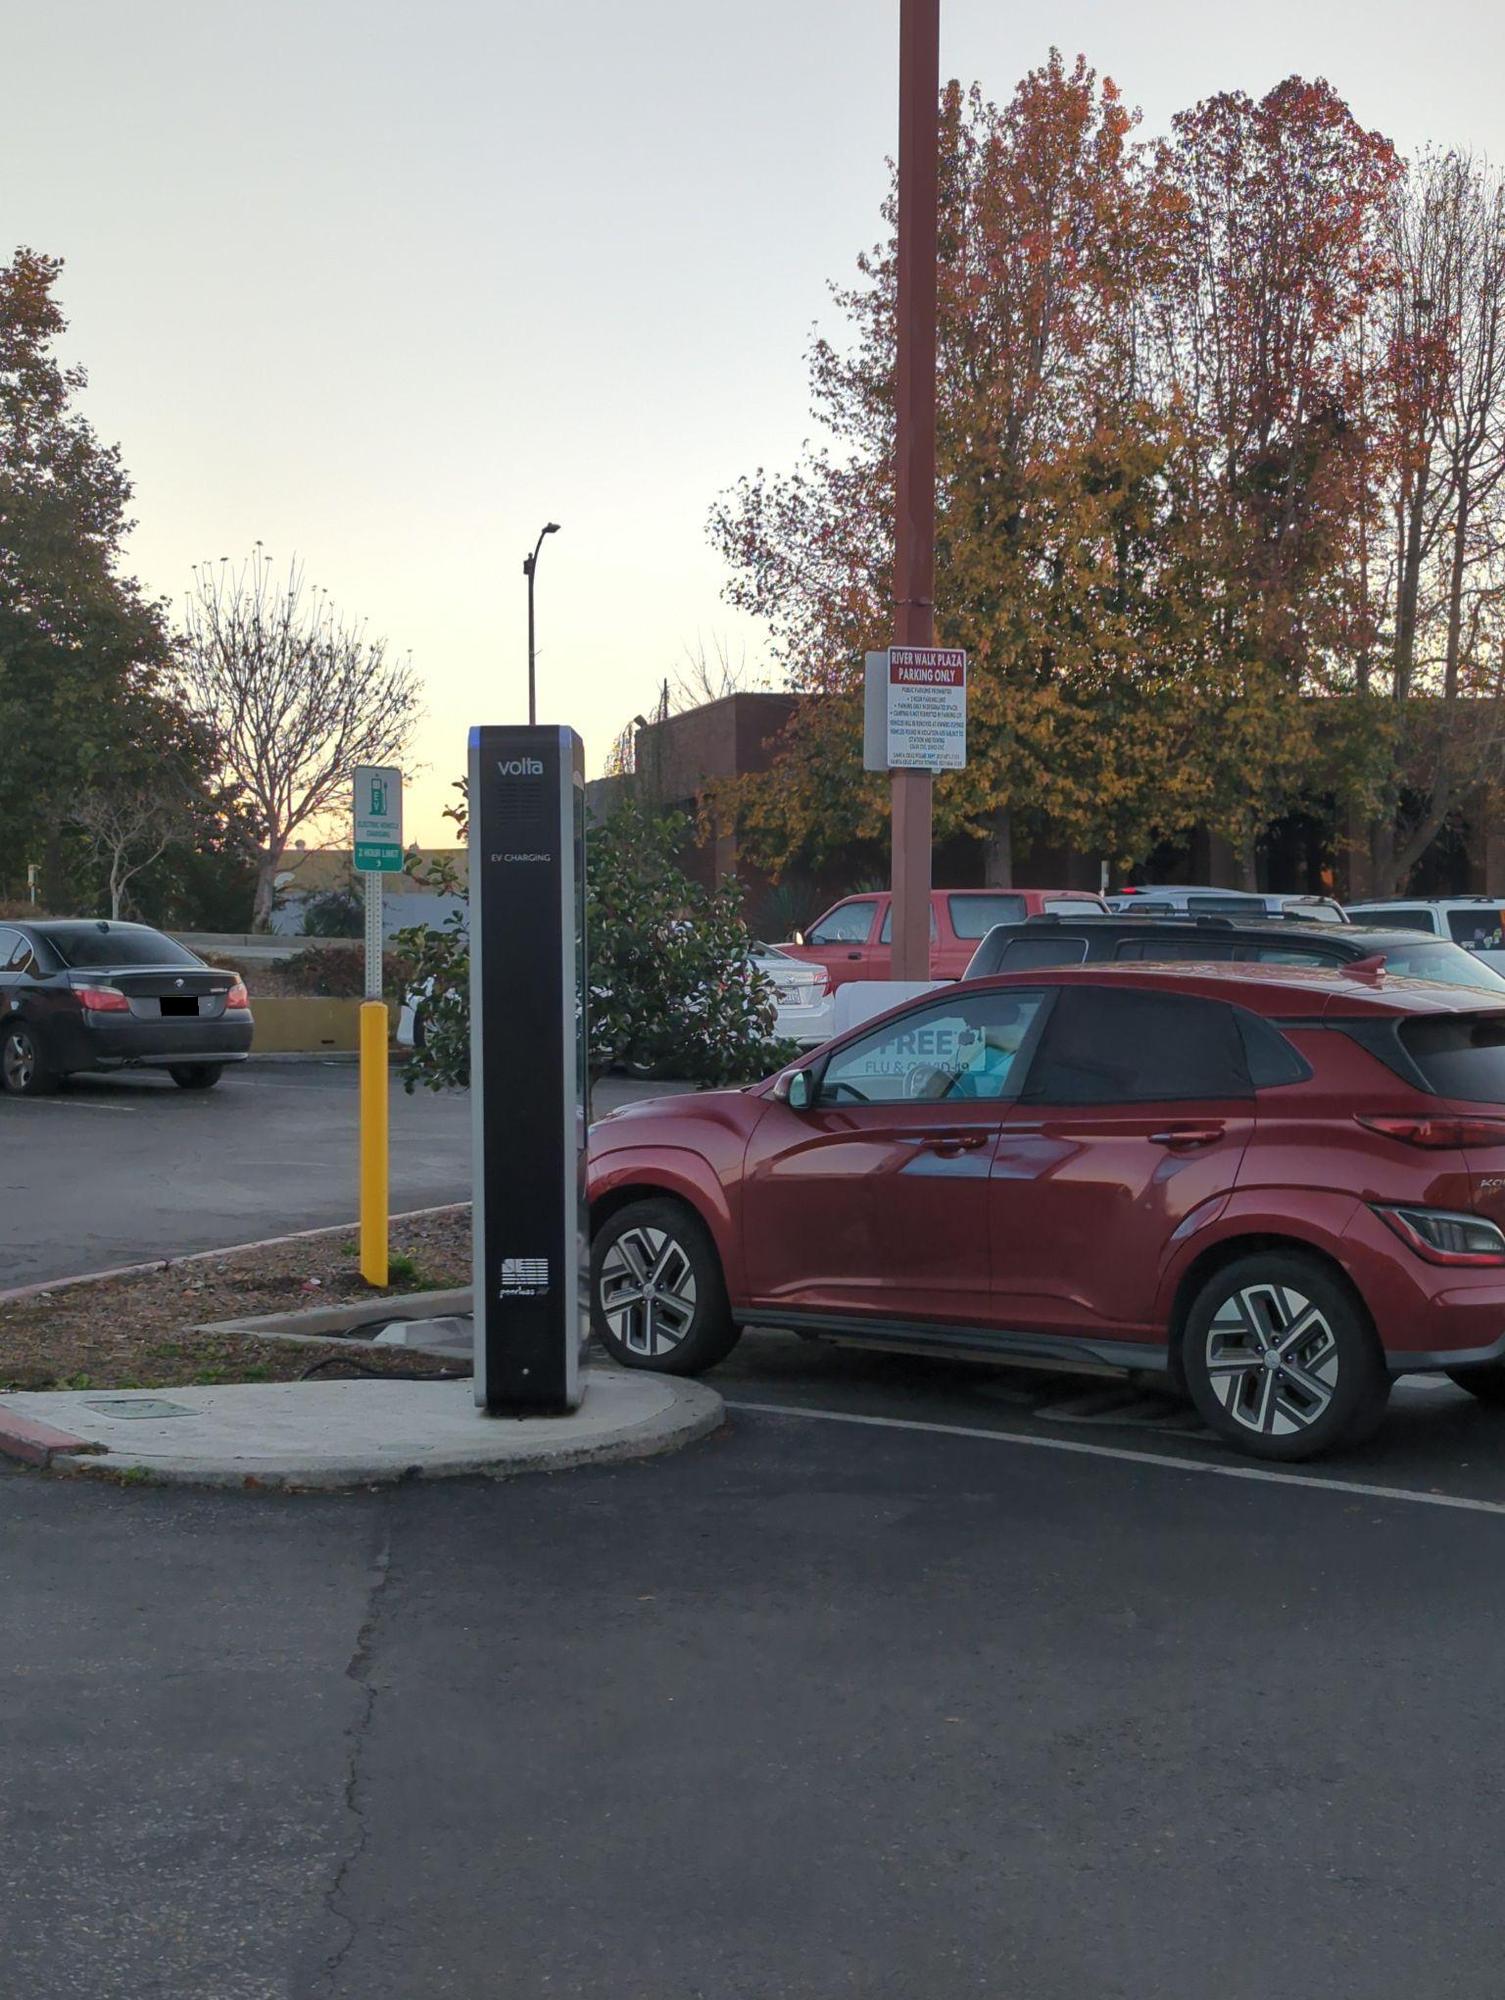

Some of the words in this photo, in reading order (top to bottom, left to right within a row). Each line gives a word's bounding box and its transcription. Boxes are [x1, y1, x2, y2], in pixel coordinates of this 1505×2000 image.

[891, 651, 913, 664] RIVER
[914, 652, 936, 666] WALK
[938, 654, 962, 667] PLAZA
[898, 667, 933, 681] PARKING
[934, 669, 955, 682] ONLY
[497, 757, 544, 775] volta
[491, 853, 502, 861] EV
[504, 854, 551, 862] CHARGING
[865, 1061, 890, 1073] FLU
